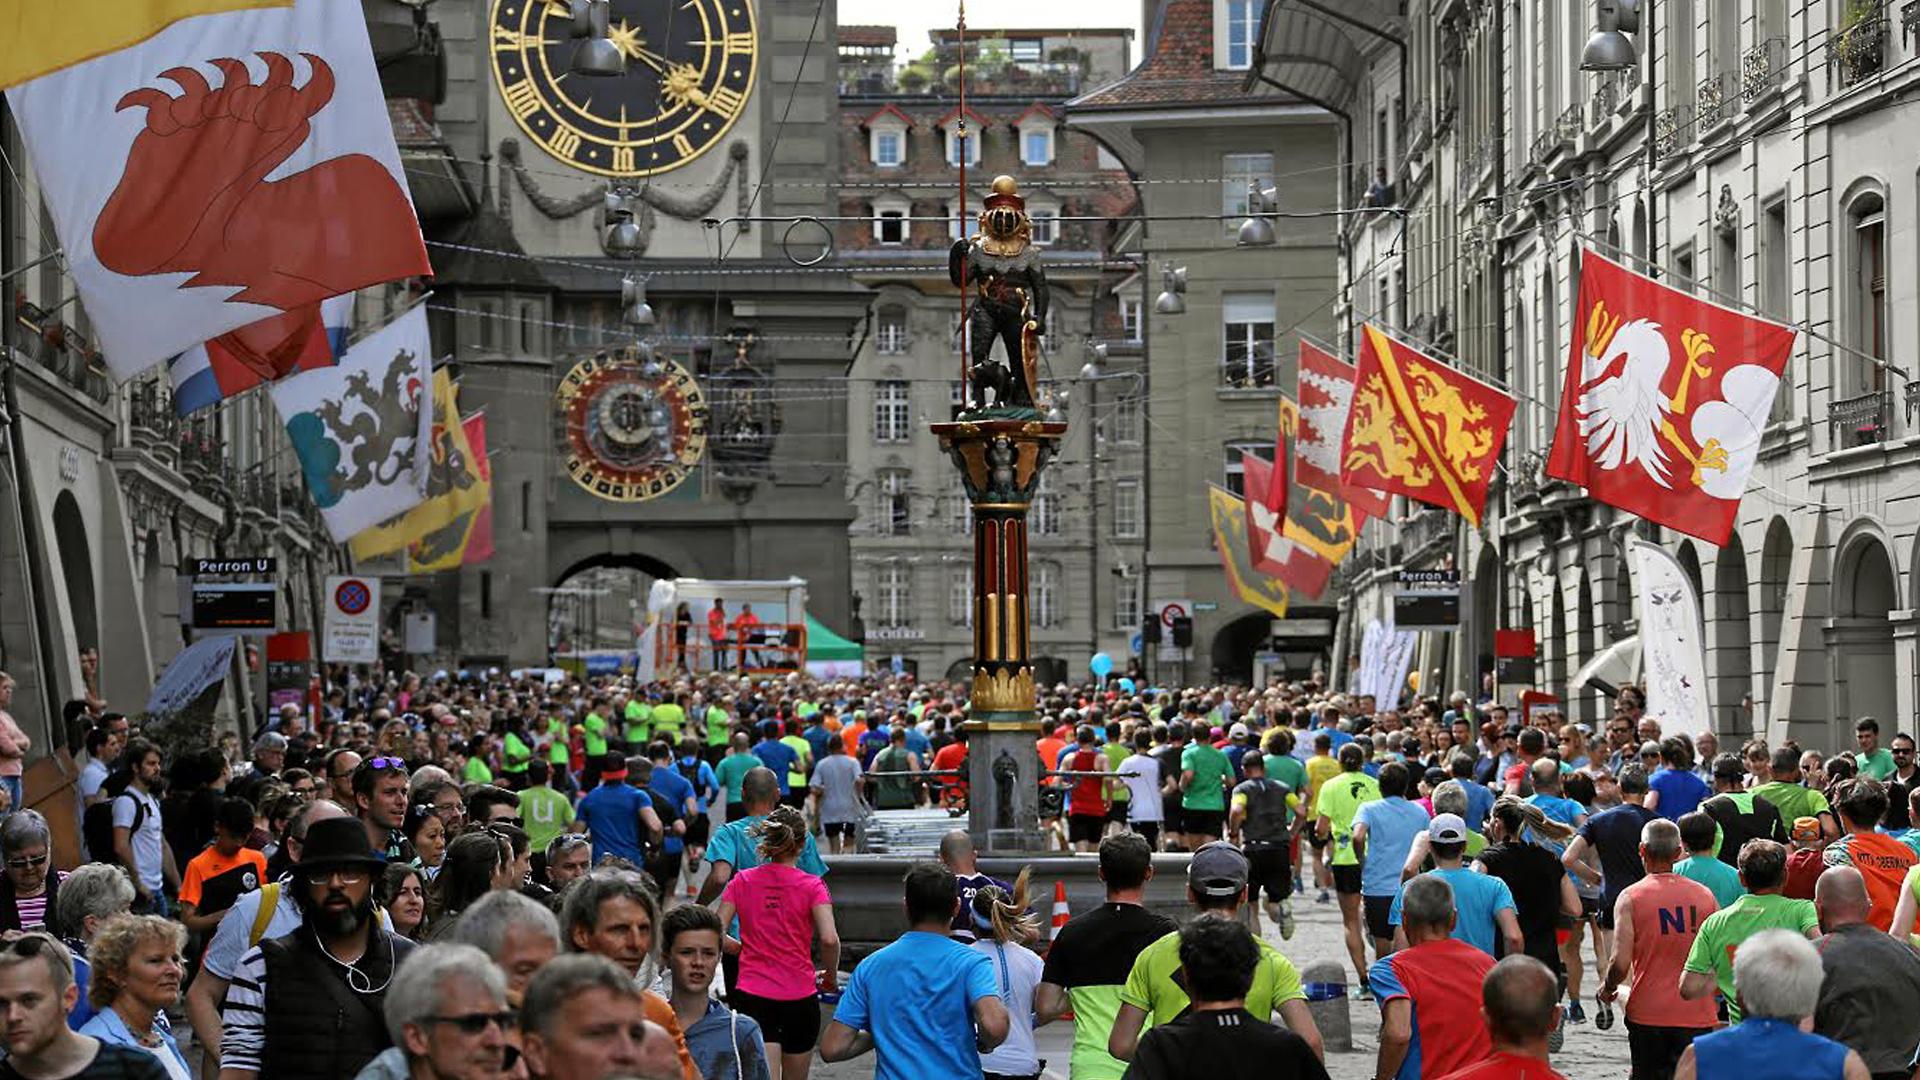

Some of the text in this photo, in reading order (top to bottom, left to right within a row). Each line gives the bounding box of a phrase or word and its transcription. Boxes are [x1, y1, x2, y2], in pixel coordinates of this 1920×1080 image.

[199, 559, 268, 572] Perron U
[1399, 571, 1454, 581] Perron T
